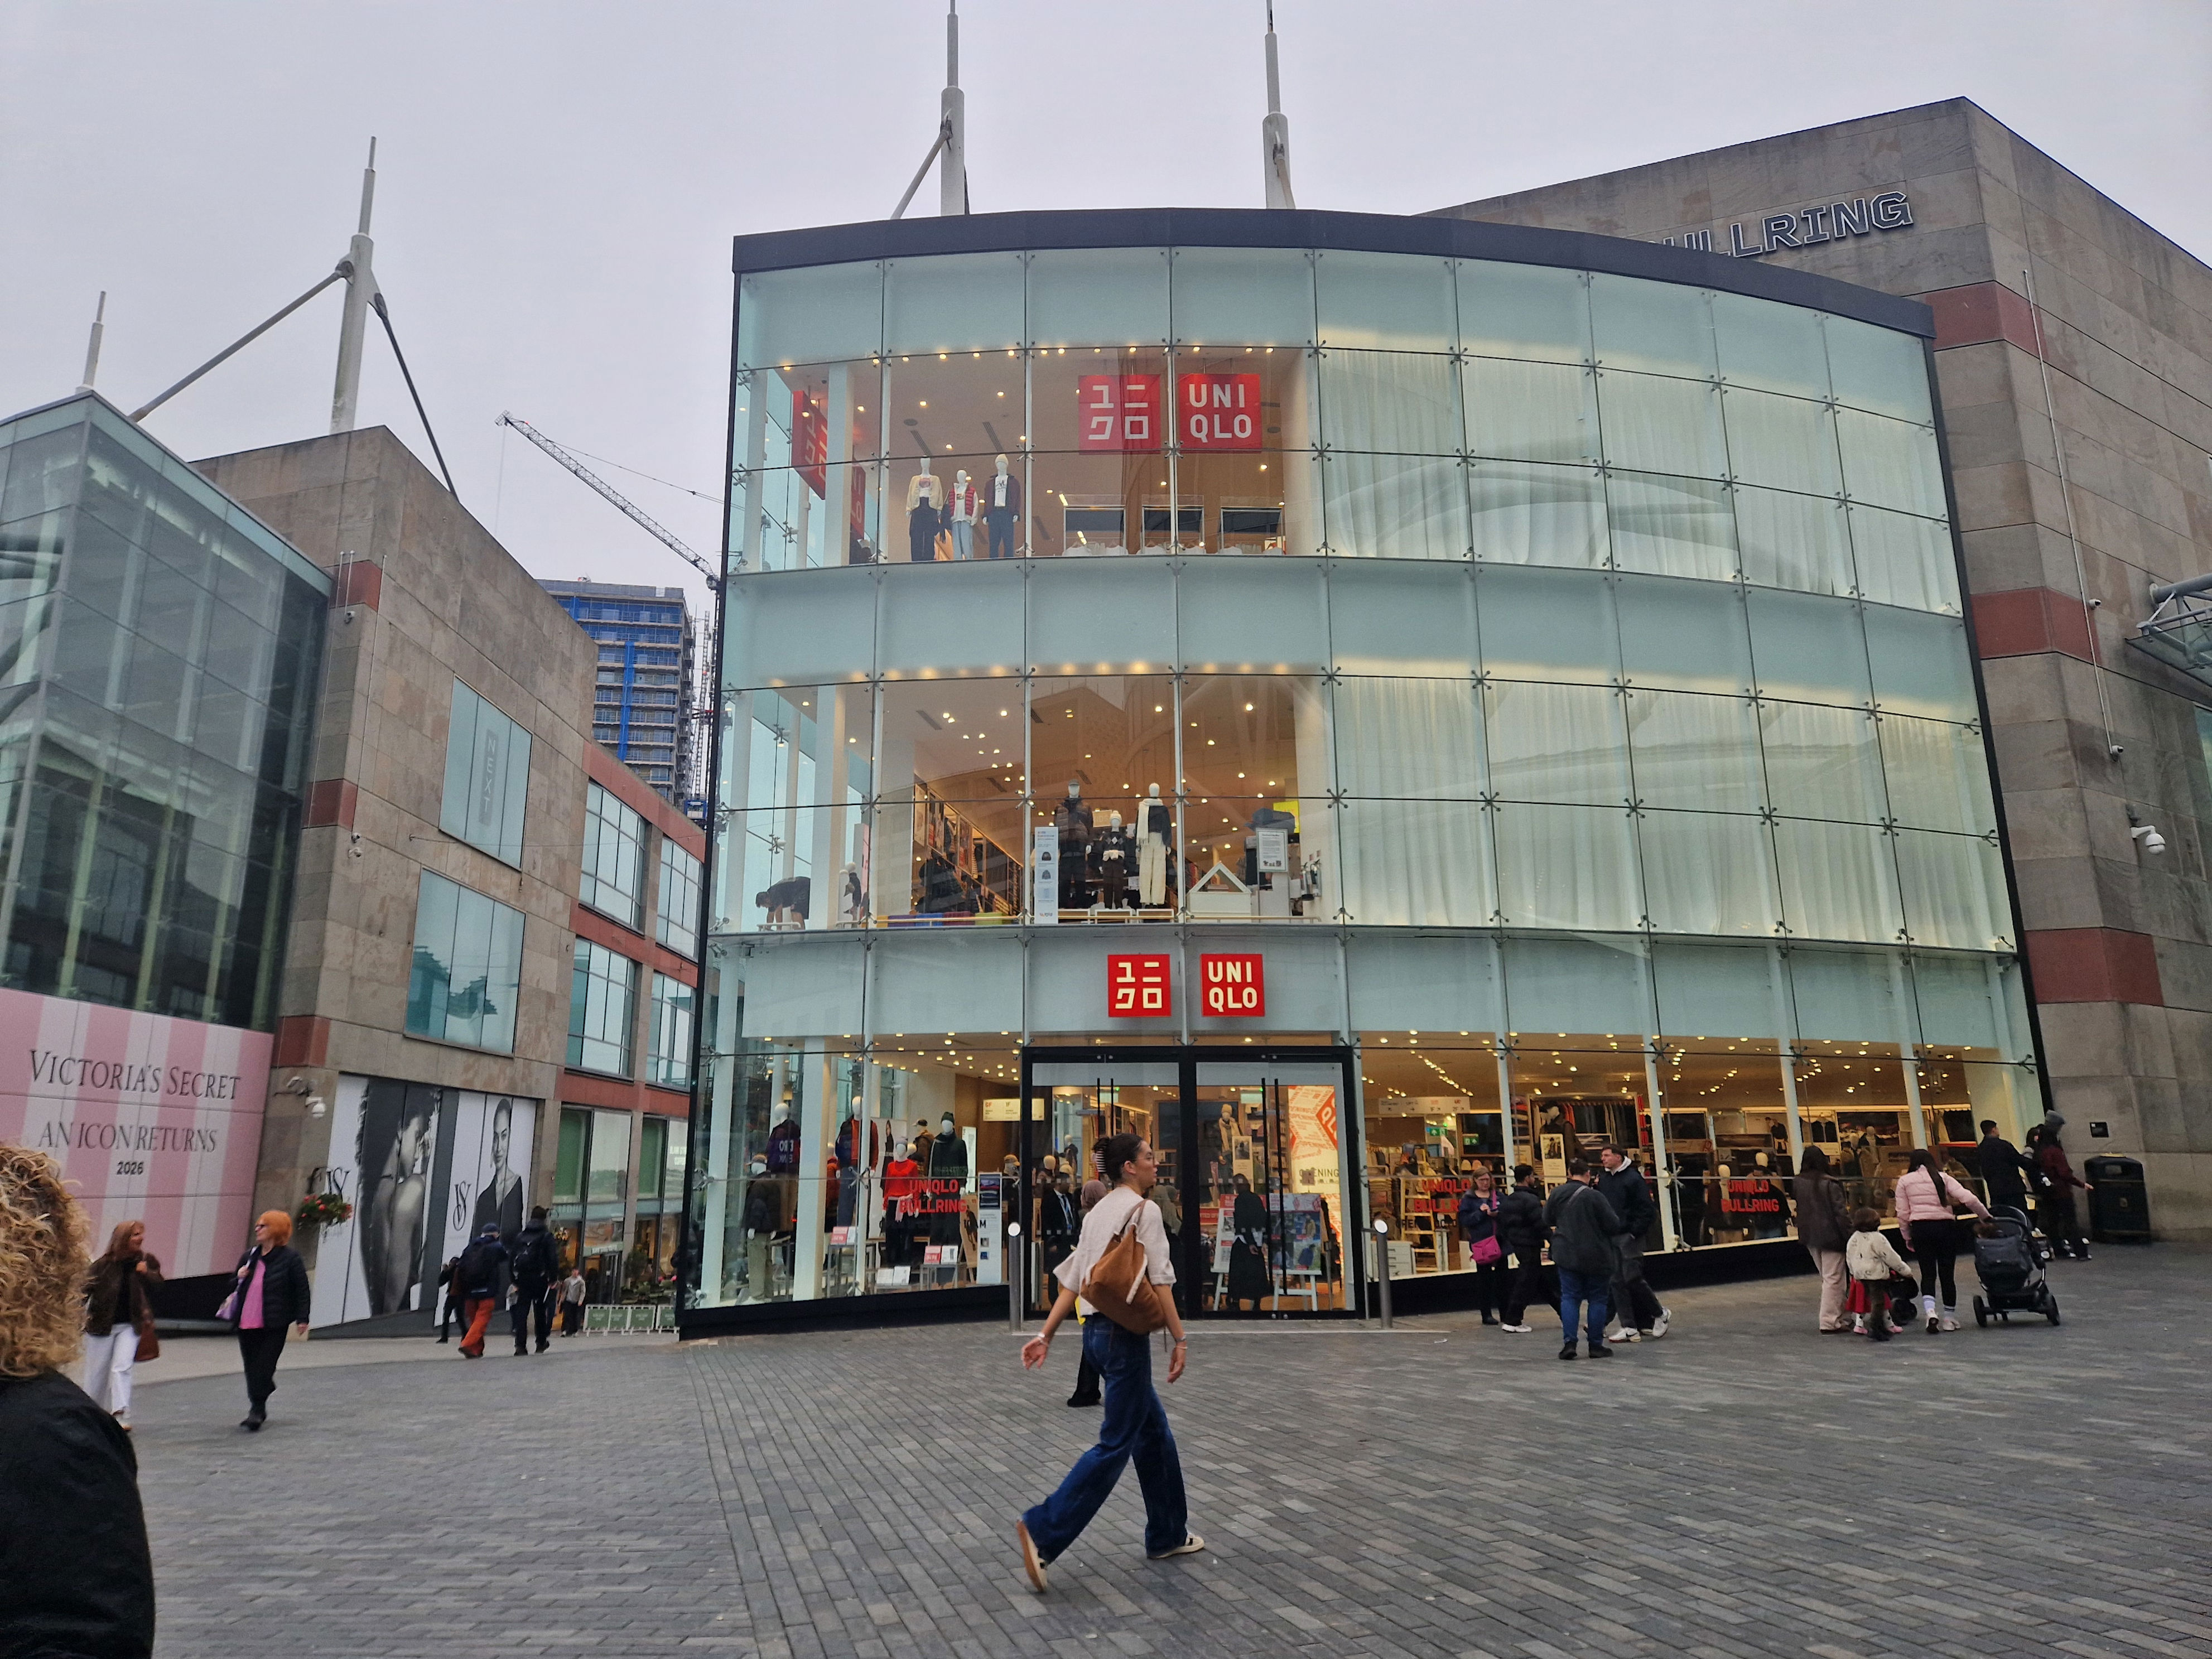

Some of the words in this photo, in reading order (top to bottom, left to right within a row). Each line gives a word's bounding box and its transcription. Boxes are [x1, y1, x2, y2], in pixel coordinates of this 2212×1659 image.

[1648, 191, 1914, 258] LLRING
[1090, 384, 1148, 409] ユニ
[1189, 383, 1245, 408] UNI
[1088, 416, 1149, 440] クロ
[1190, 414, 1252, 443] QLO
[484, 736, 496, 812] NEXT
[1116, 962, 1162, 983] ユニ
[1208, 961, 1252, 983] UNI
[1115, 988, 1162, 1009] クロ
[1209, 987, 1257, 1012] QLO
[30, 1049, 162, 1093] VICTORIA'S
[167, 1065, 241, 1100] SECRET
[38, 1121, 74, 1148] AN
[77, 1122, 134, 1150] ICON
[134, 1125, 217, 1153] RETURNS
[115, 1160, 144, 1175] 2026
[1299, 1169, 1339, 1177] ENING
[909, 1179, 959, 1196] UNIQLO
[1421, 1178, 1472, 1195] UNIQLO
[1727, 1179, 1770, 1195] UNIQLO
[899, 1199, 968, 1213] BULLRING
[1414, 1199, 1462, 1213] BULLR
[1721, 1198, 1780, 1213] BULLRING
